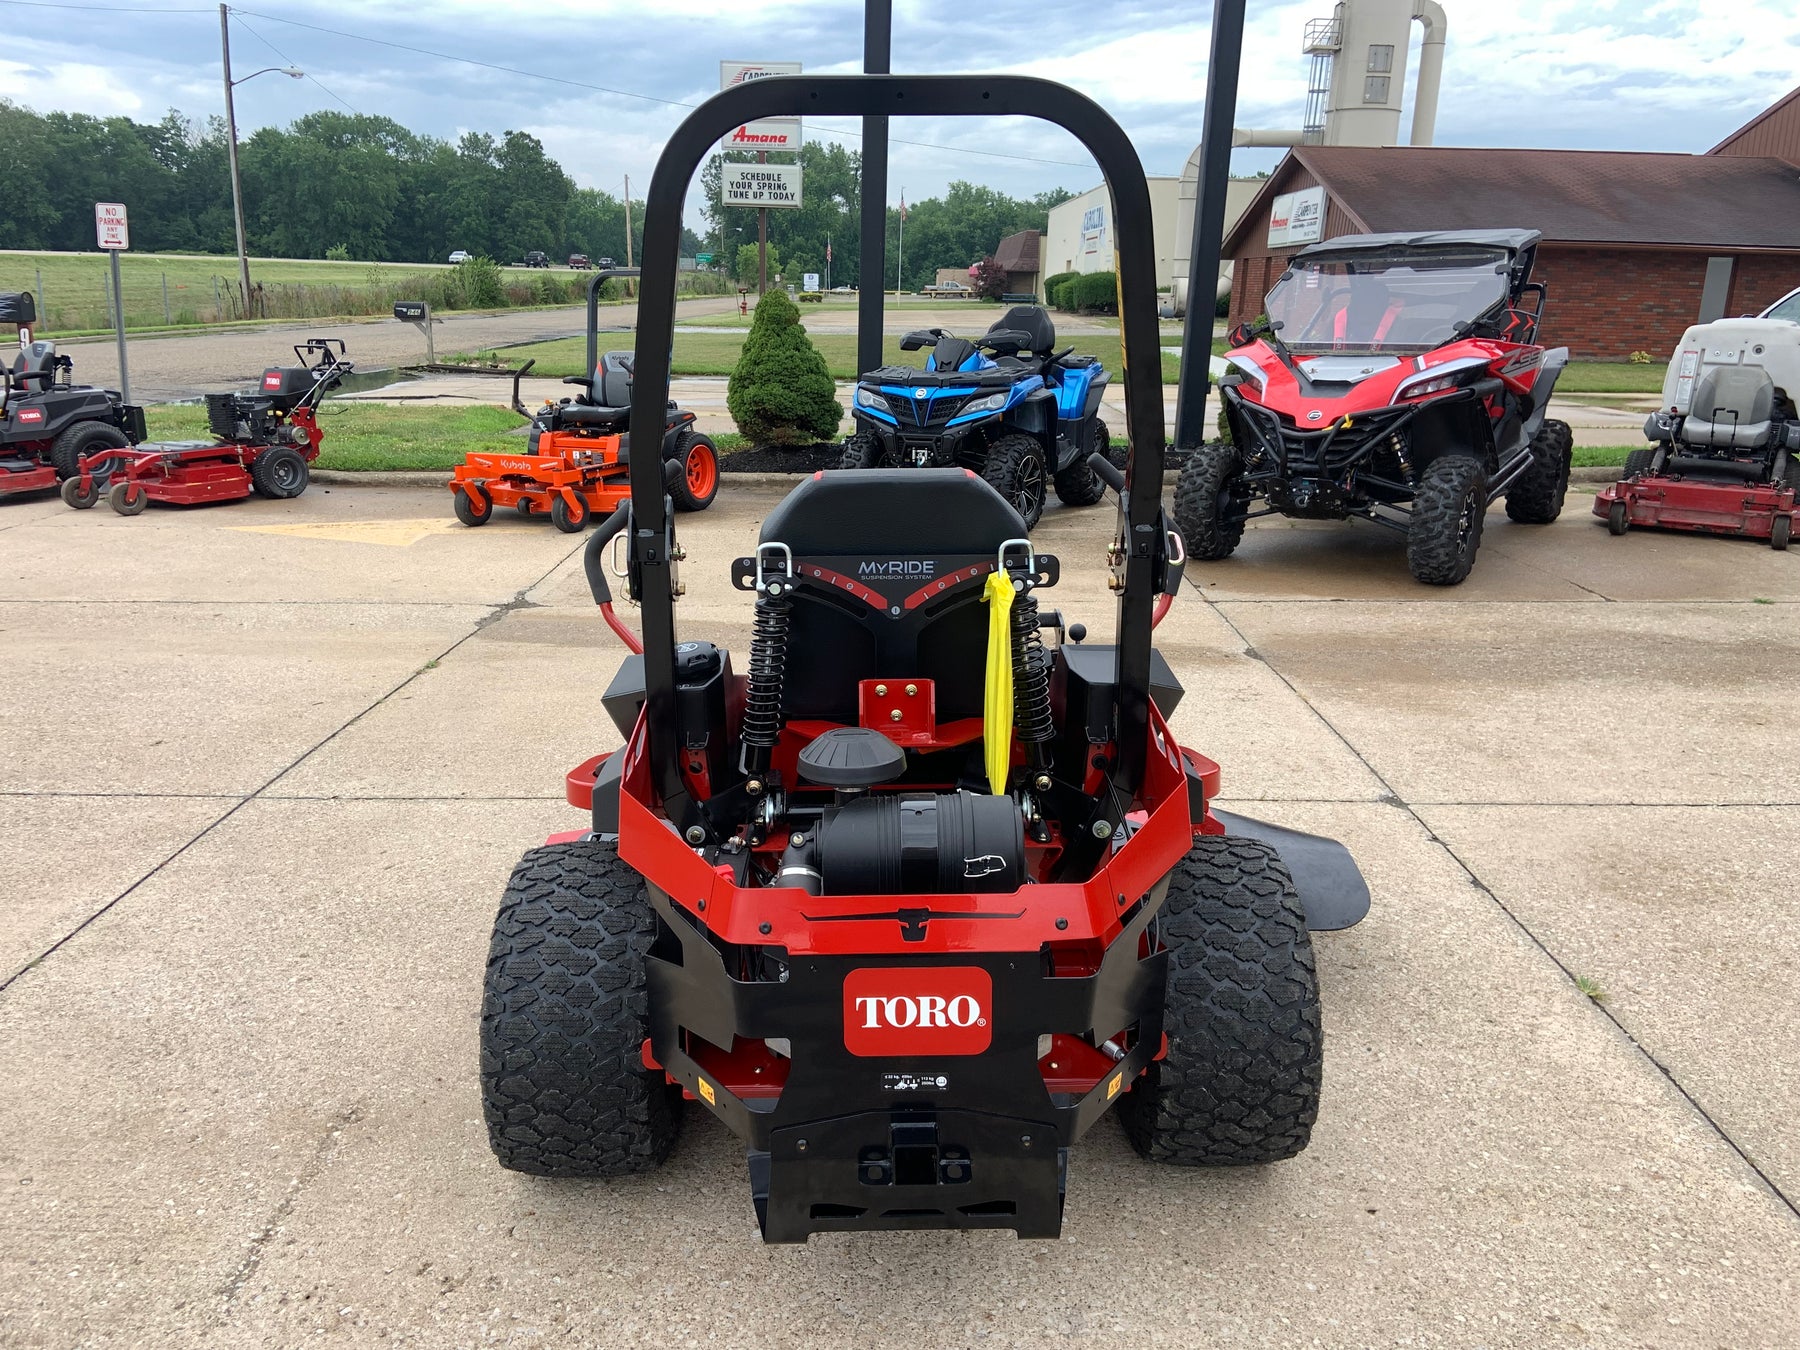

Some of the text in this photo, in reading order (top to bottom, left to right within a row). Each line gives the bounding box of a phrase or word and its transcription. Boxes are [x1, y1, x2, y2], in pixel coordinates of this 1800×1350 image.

[732, 126, 788, 143] Amana
[740, 172, 782, 182] SCHEDULE
[729, 181, 788, 191] YOUR SPRING
[728, 190, 796, 201] TUNE UP TODAY
[105, 207, 117, 217] NO
[98, 217, 125, 226] PARKING
[20, 412, 42, 420] TORO
[500, 459, 532, 471] Kubota
